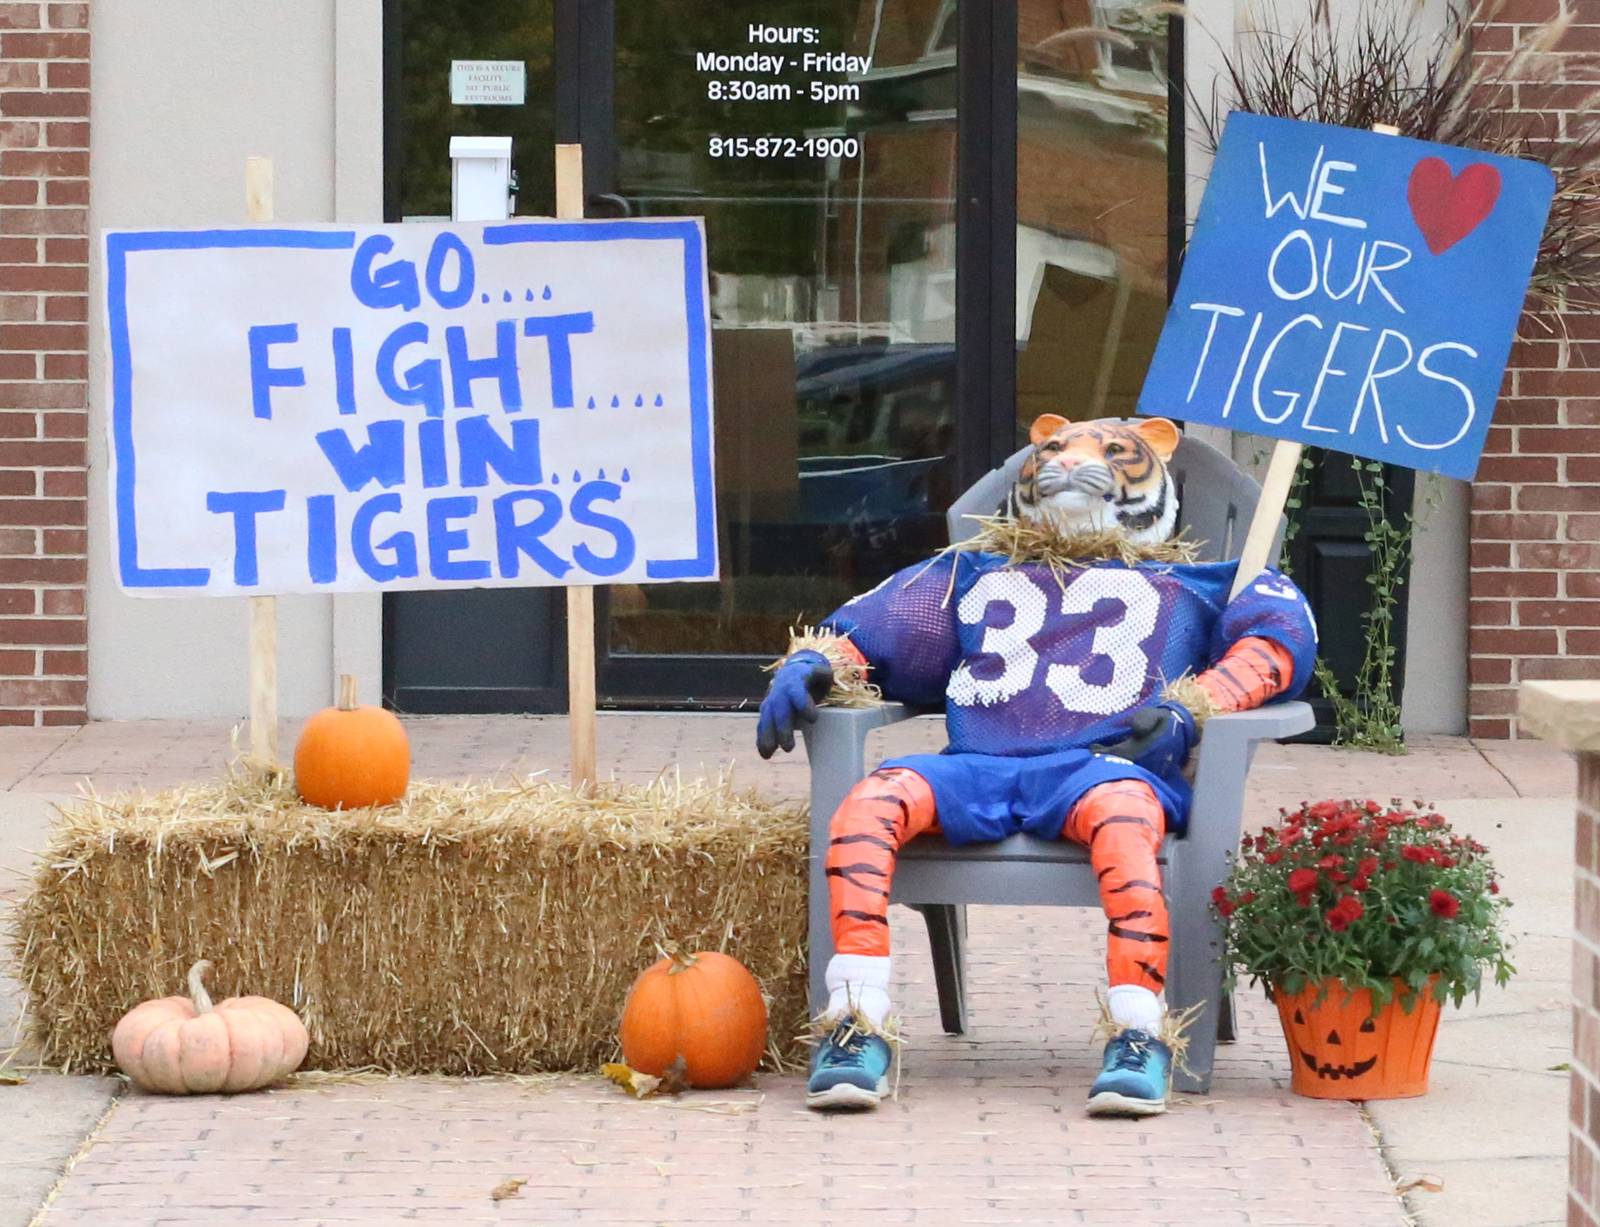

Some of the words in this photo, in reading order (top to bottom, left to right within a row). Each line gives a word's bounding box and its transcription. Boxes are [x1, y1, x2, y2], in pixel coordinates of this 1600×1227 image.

[695, 51, 785, 75] Monday
[802, 51, 873, 75] Friday
[748, 23, 820, 44] Hours:
[707, 80, 791, 101] 8:30am
[810, 80, 860, 104] 5pm
[708, 137, 859, 159] 815-872-1900
[1259, 142, 1367, 229] WE
[1268, 229, 1412, 314] OUR
[1187, 302, 1479, 450] TIGERS
[206, 481, 637, 587] TIGERS
[945, 567, 1162, 716] 33
